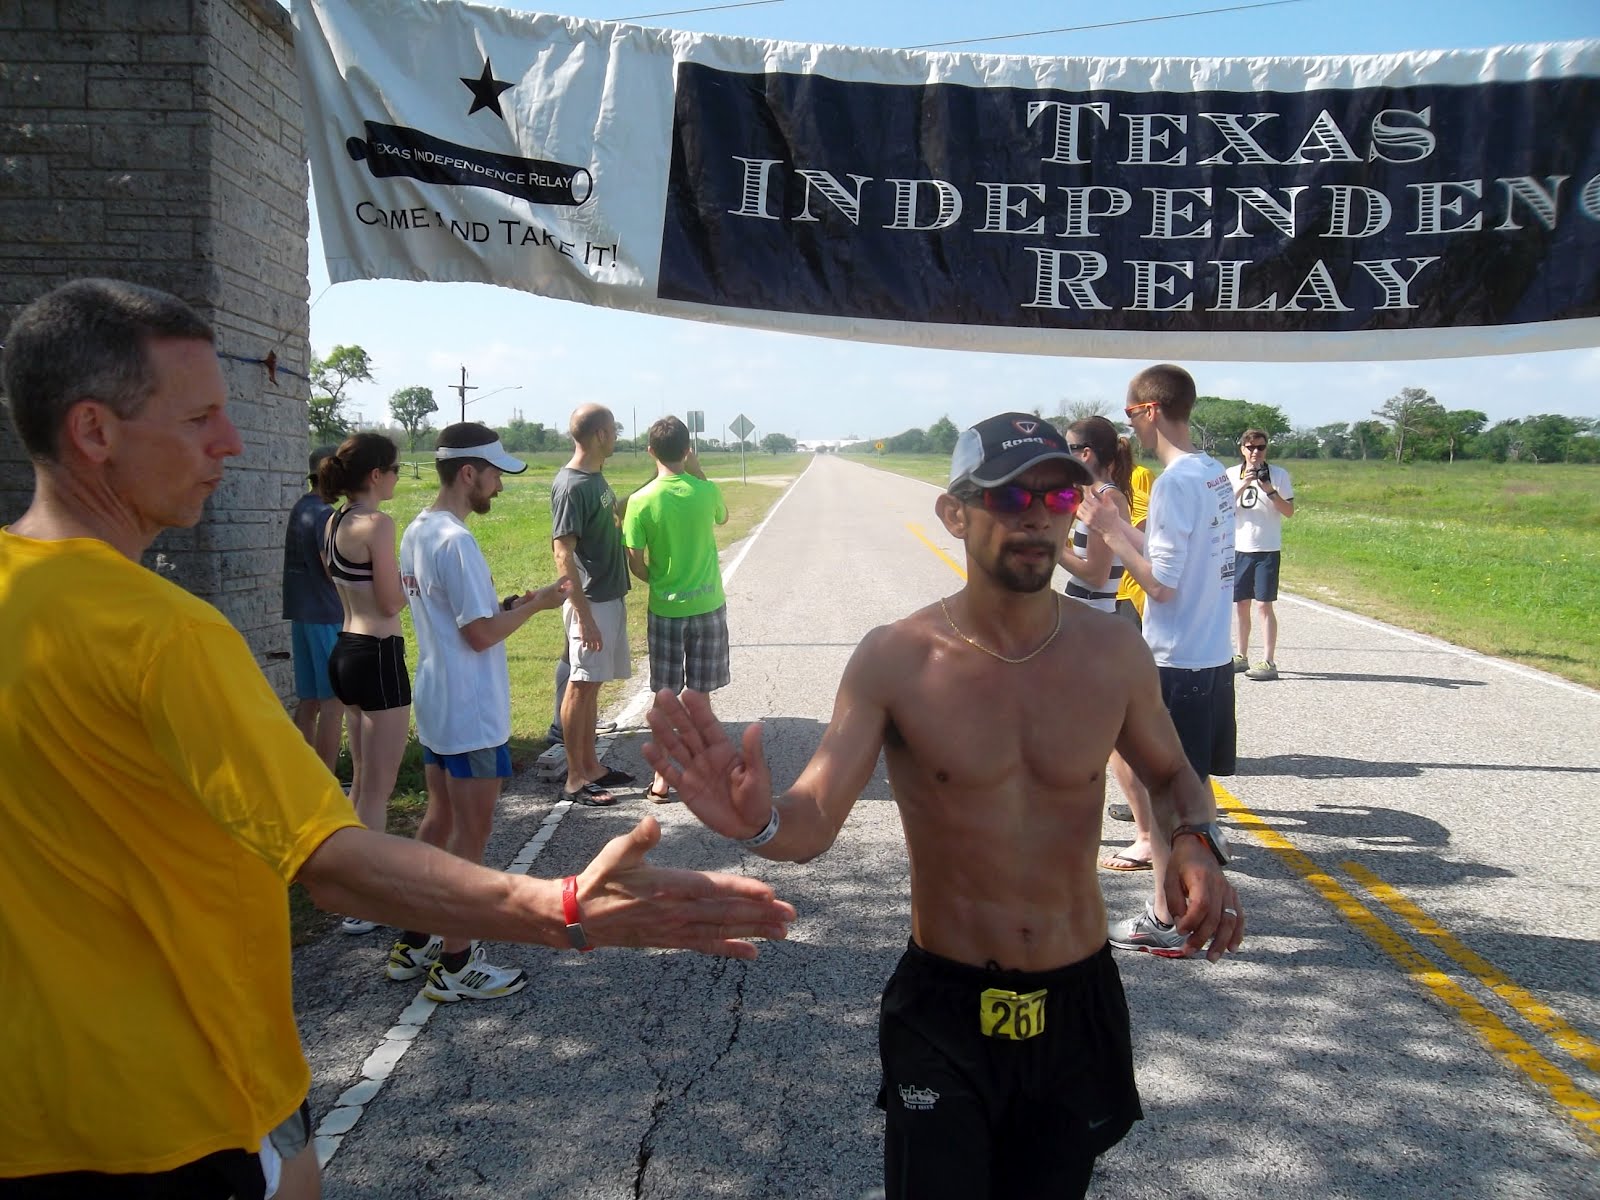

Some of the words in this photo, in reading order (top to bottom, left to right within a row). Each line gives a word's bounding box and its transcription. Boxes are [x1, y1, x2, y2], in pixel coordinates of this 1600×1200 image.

[371, 143, 411, 160] EXAS
[414, 148, 526, 184] INDEPENDENCE
[528, 172, 572, 189] RELAY
[1026, 101, 1437, 166] TEXAS
[355, 201, 430, 230] COME
[498, 219, 576, 260] TAKE
[583, 241, 617, 268] IT!
[1021, 246, 1441, 313] RELAY
[991, 996, 1046, 1040] 267
